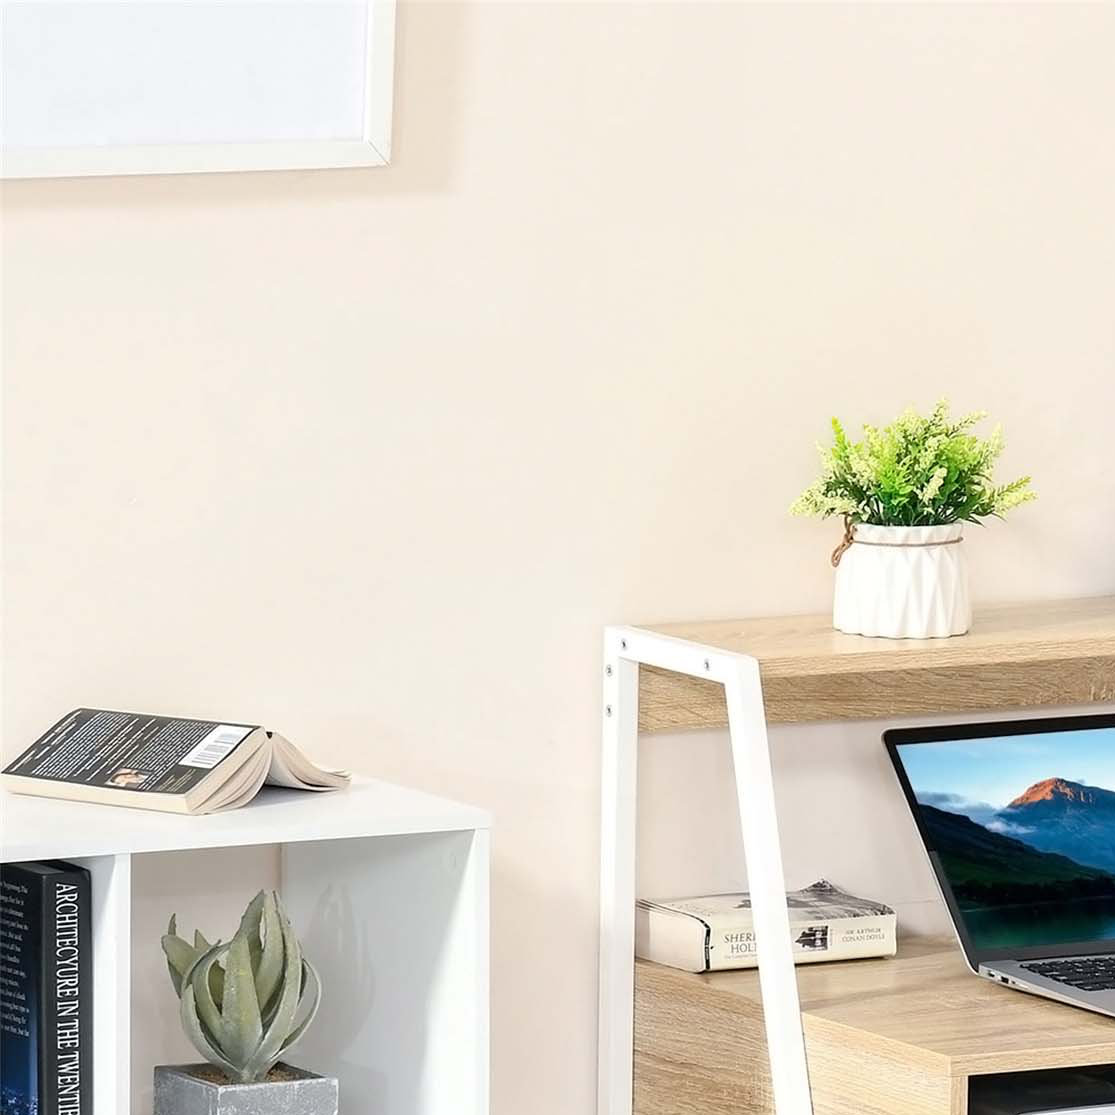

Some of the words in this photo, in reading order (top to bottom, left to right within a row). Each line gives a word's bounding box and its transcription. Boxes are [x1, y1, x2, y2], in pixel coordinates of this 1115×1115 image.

[56, 883, 79, 997] ARCHITECYURE
[57, 1001, 79, 1017] IN
[57, 1019, 80, 1049] THE
